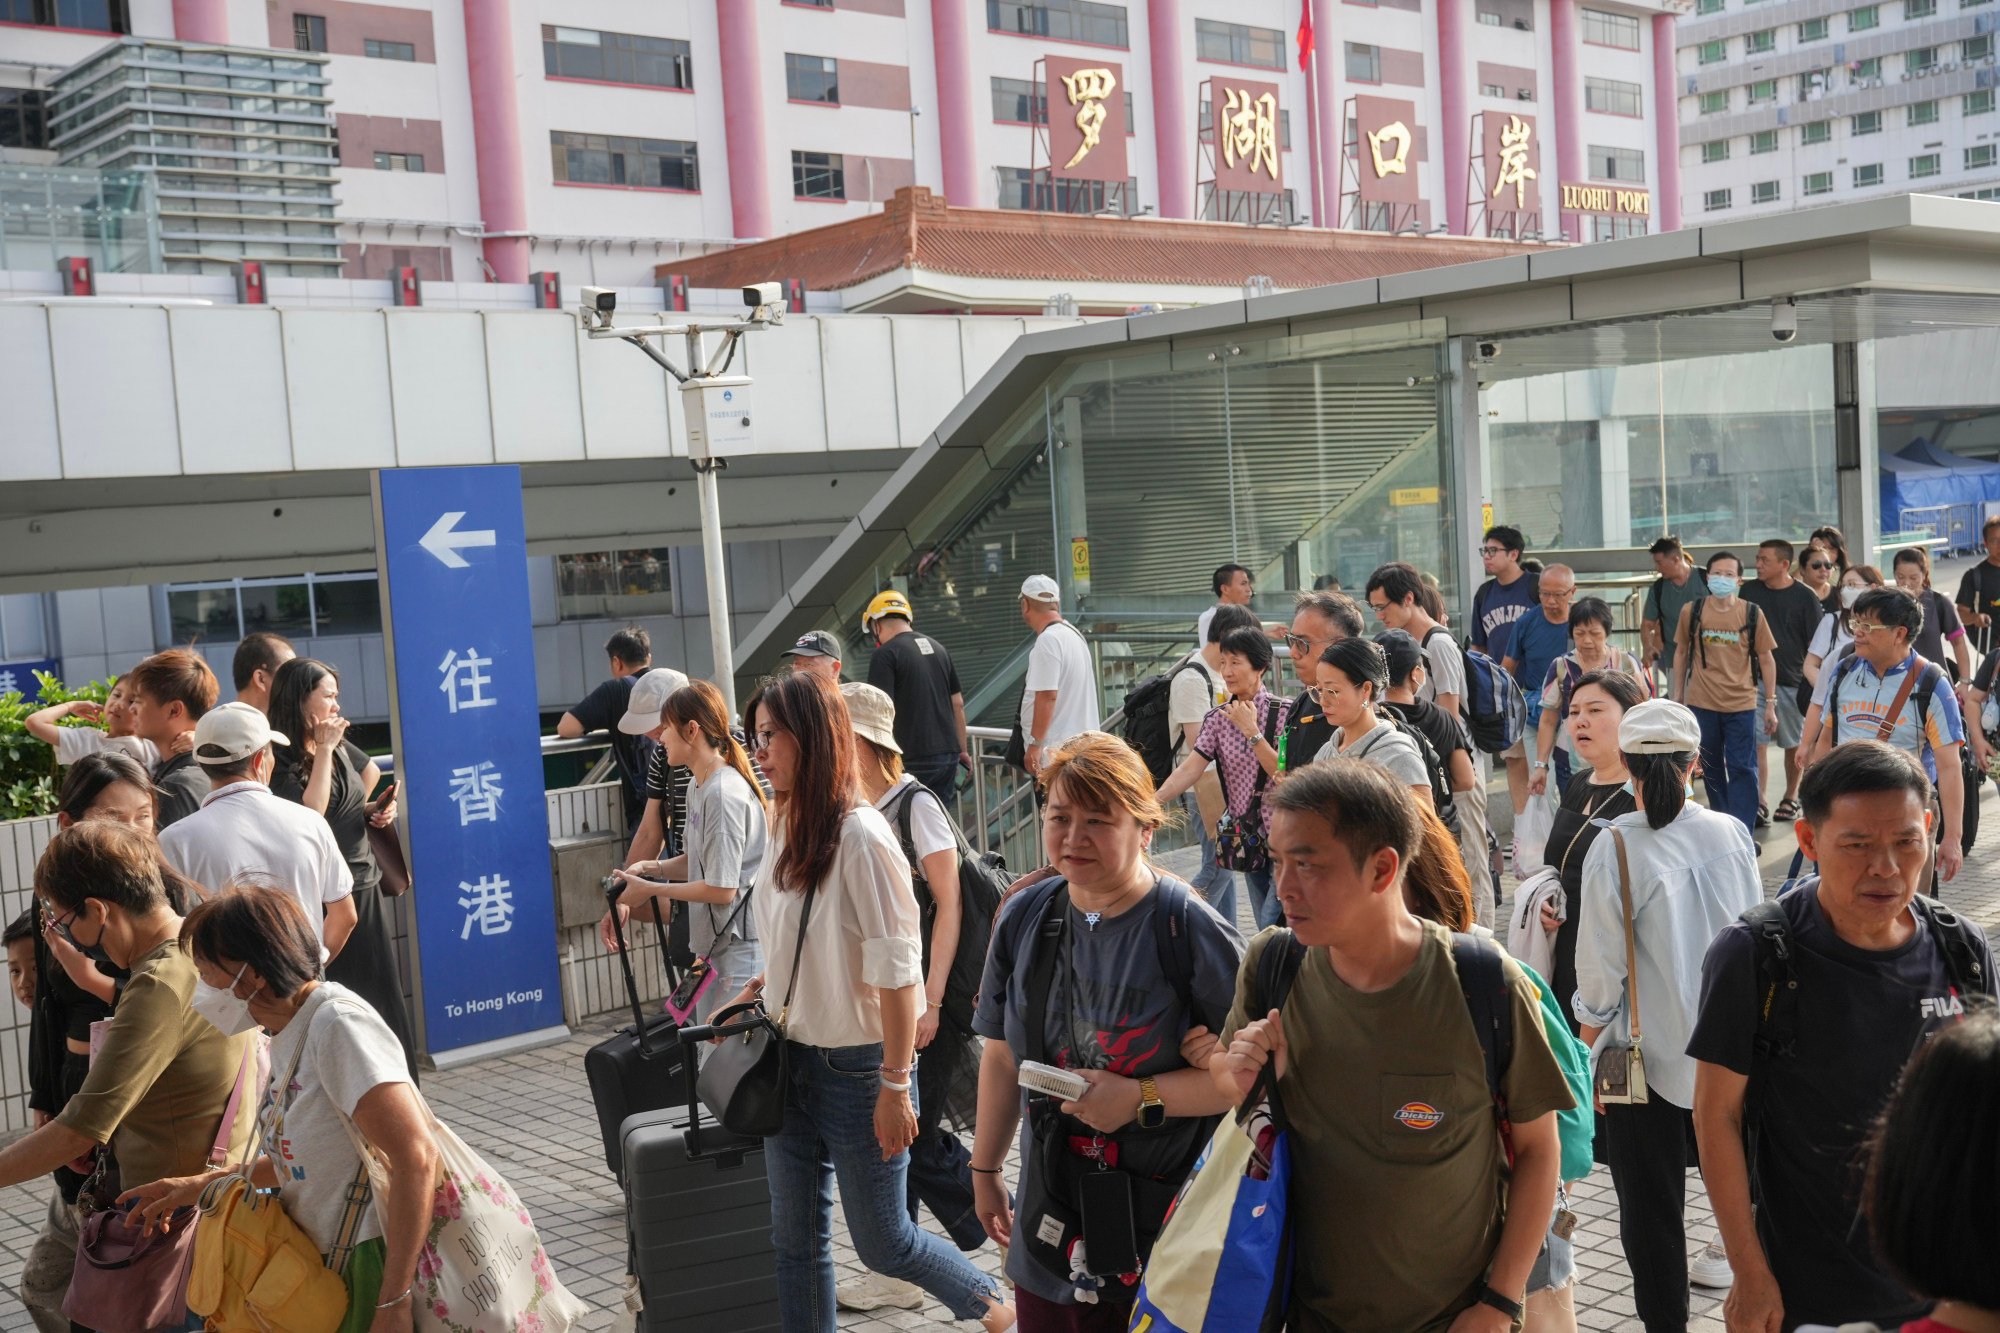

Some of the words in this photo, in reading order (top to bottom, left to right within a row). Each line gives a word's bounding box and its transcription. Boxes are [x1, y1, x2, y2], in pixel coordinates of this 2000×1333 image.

[1562, 185, 1612, 211] LUOHU
[1615, 190, 1650, 214] PORT
[438, 647, 515, 940] 往香港
[444, 1004, 463, 1018] To
[466, 997, 504, 1011] Hong
[507, 988, 543, 1005] Kong
[1920, 995, 1964, 1018] FILA
[1400, 1112, 1440, 1121] Dickies
[459, 1213, 495, 1266] BUSY
[462, 1233, 523, 1317] SHOPPING
